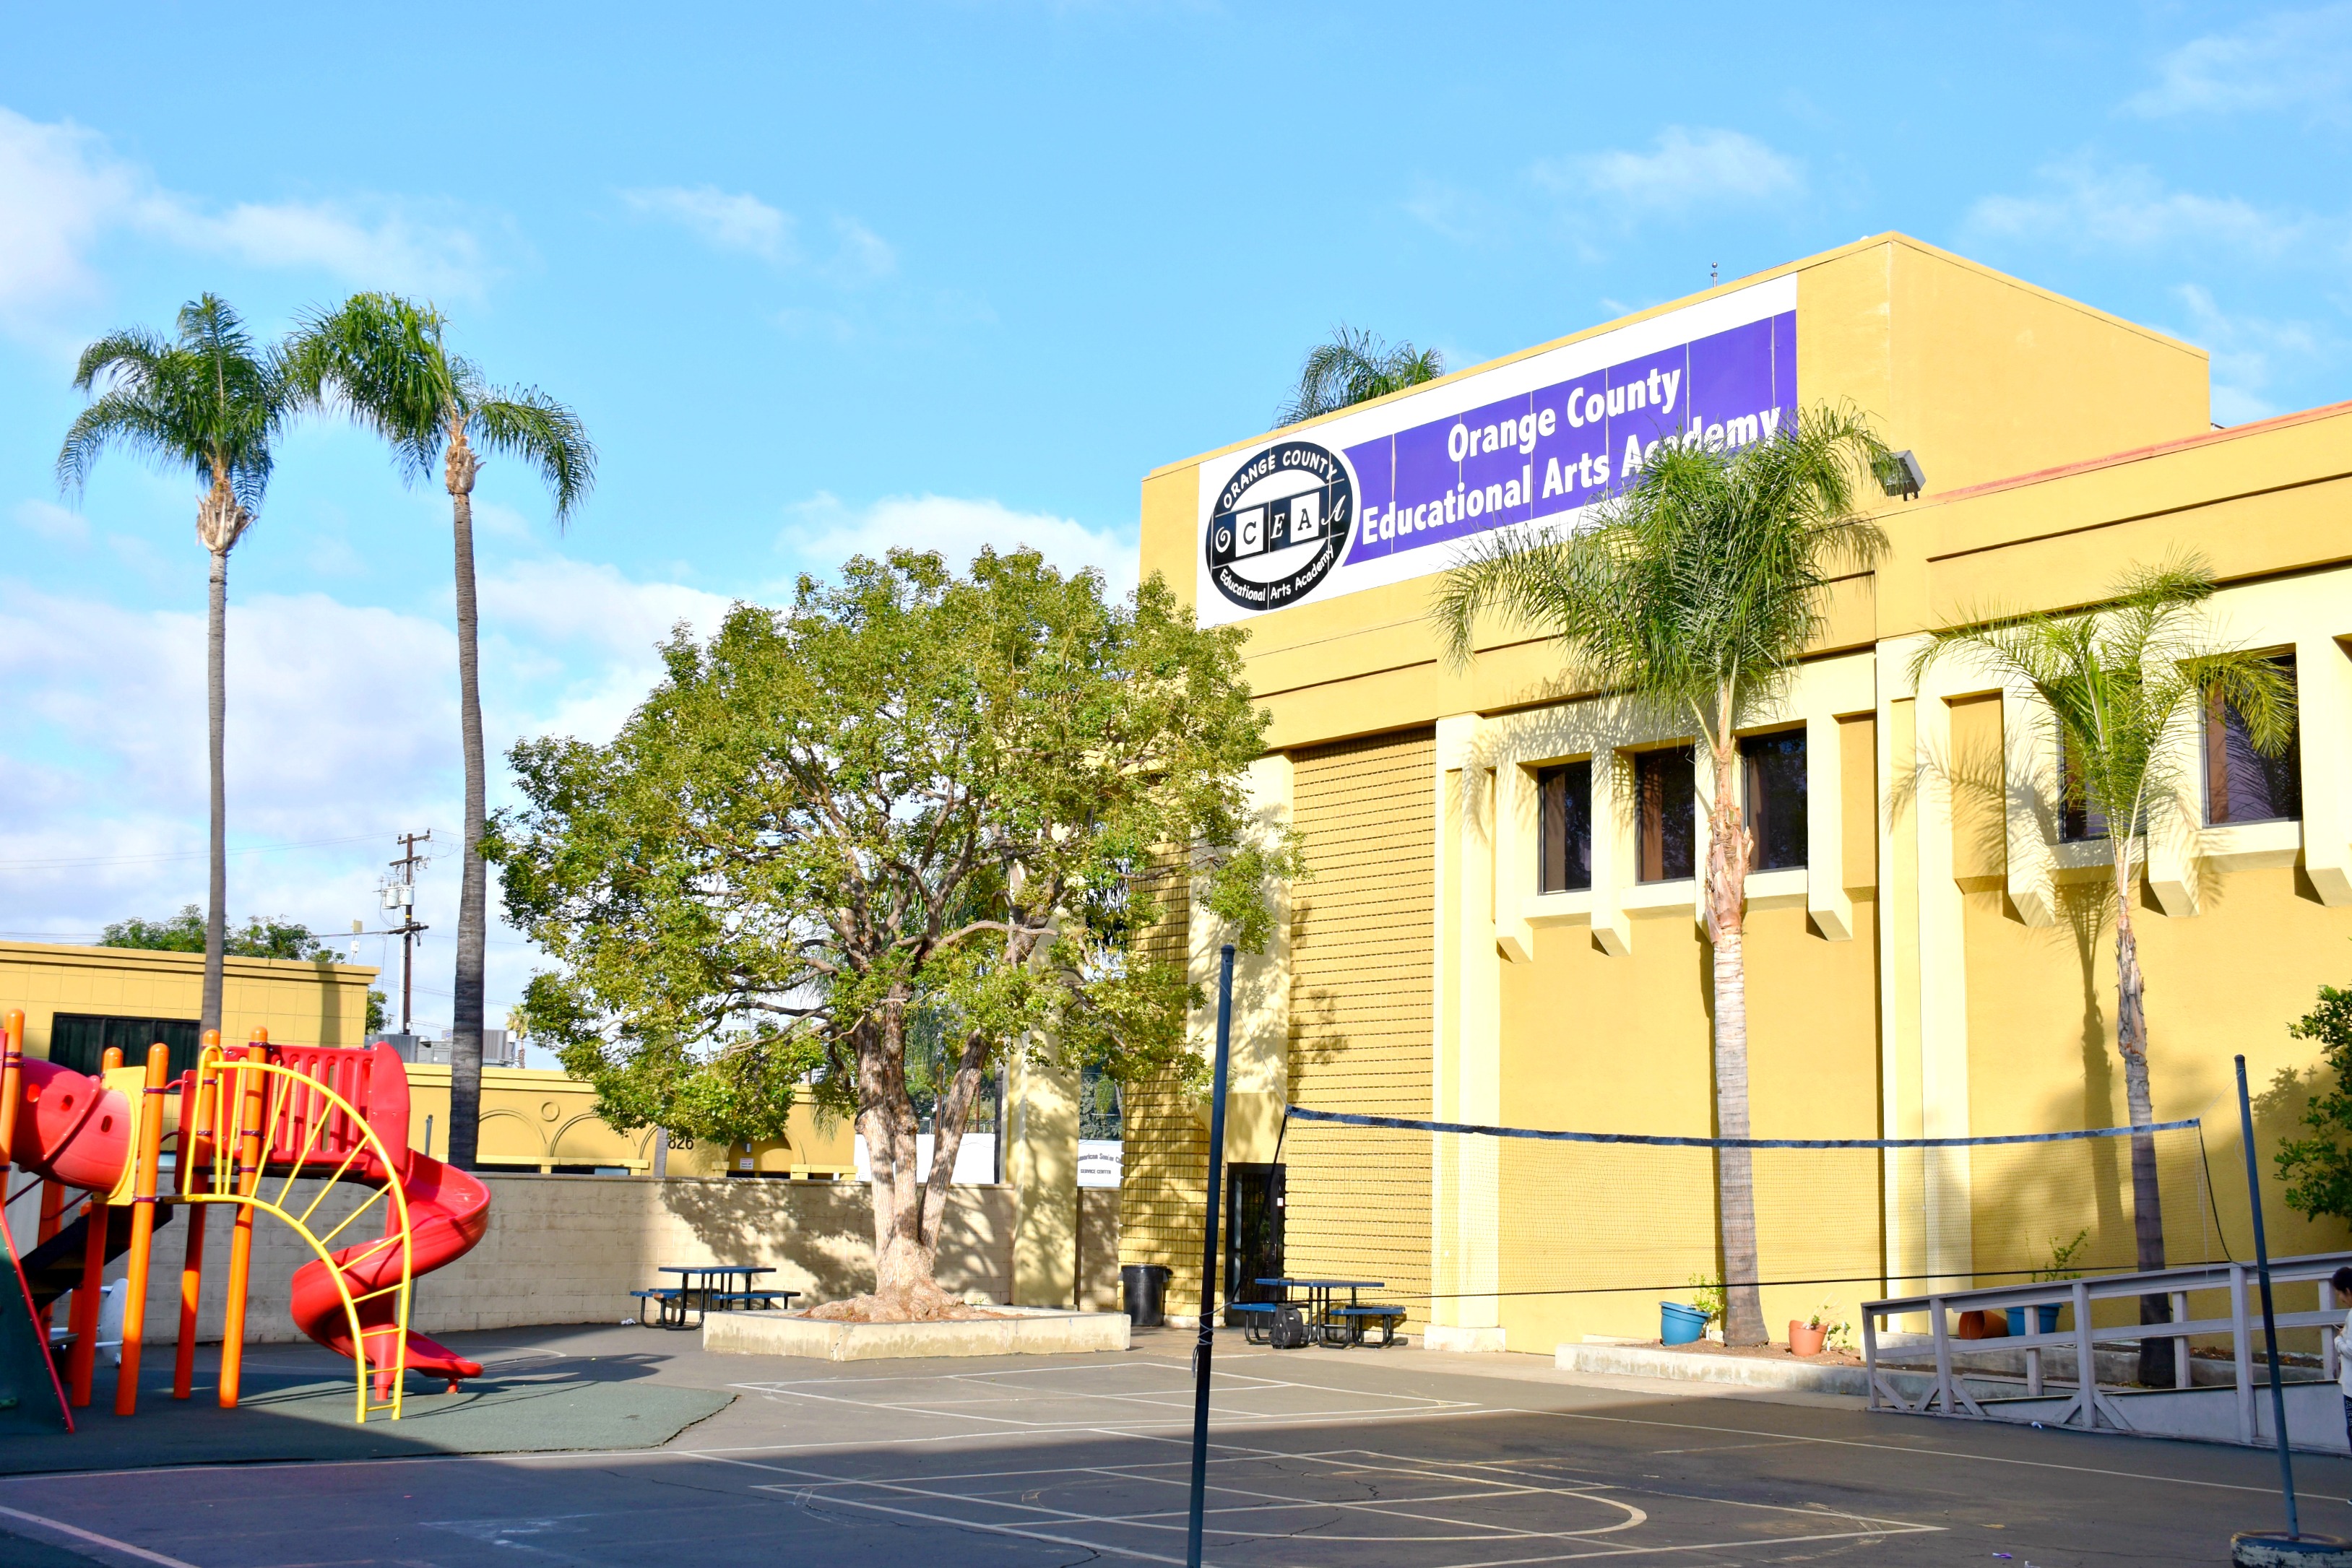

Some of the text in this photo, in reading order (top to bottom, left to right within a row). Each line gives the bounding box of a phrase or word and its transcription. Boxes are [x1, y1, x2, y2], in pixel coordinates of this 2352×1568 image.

[1448, 368, 1682, 463] Orange County
[1223, 449, 1338, 508] ORANGE COUNTY
[1362, 463, 1531, 545] Educational
[1542, 451, 1610, 499] Arts
[1219, 544, 1334, 602] Educational Arts Academy
